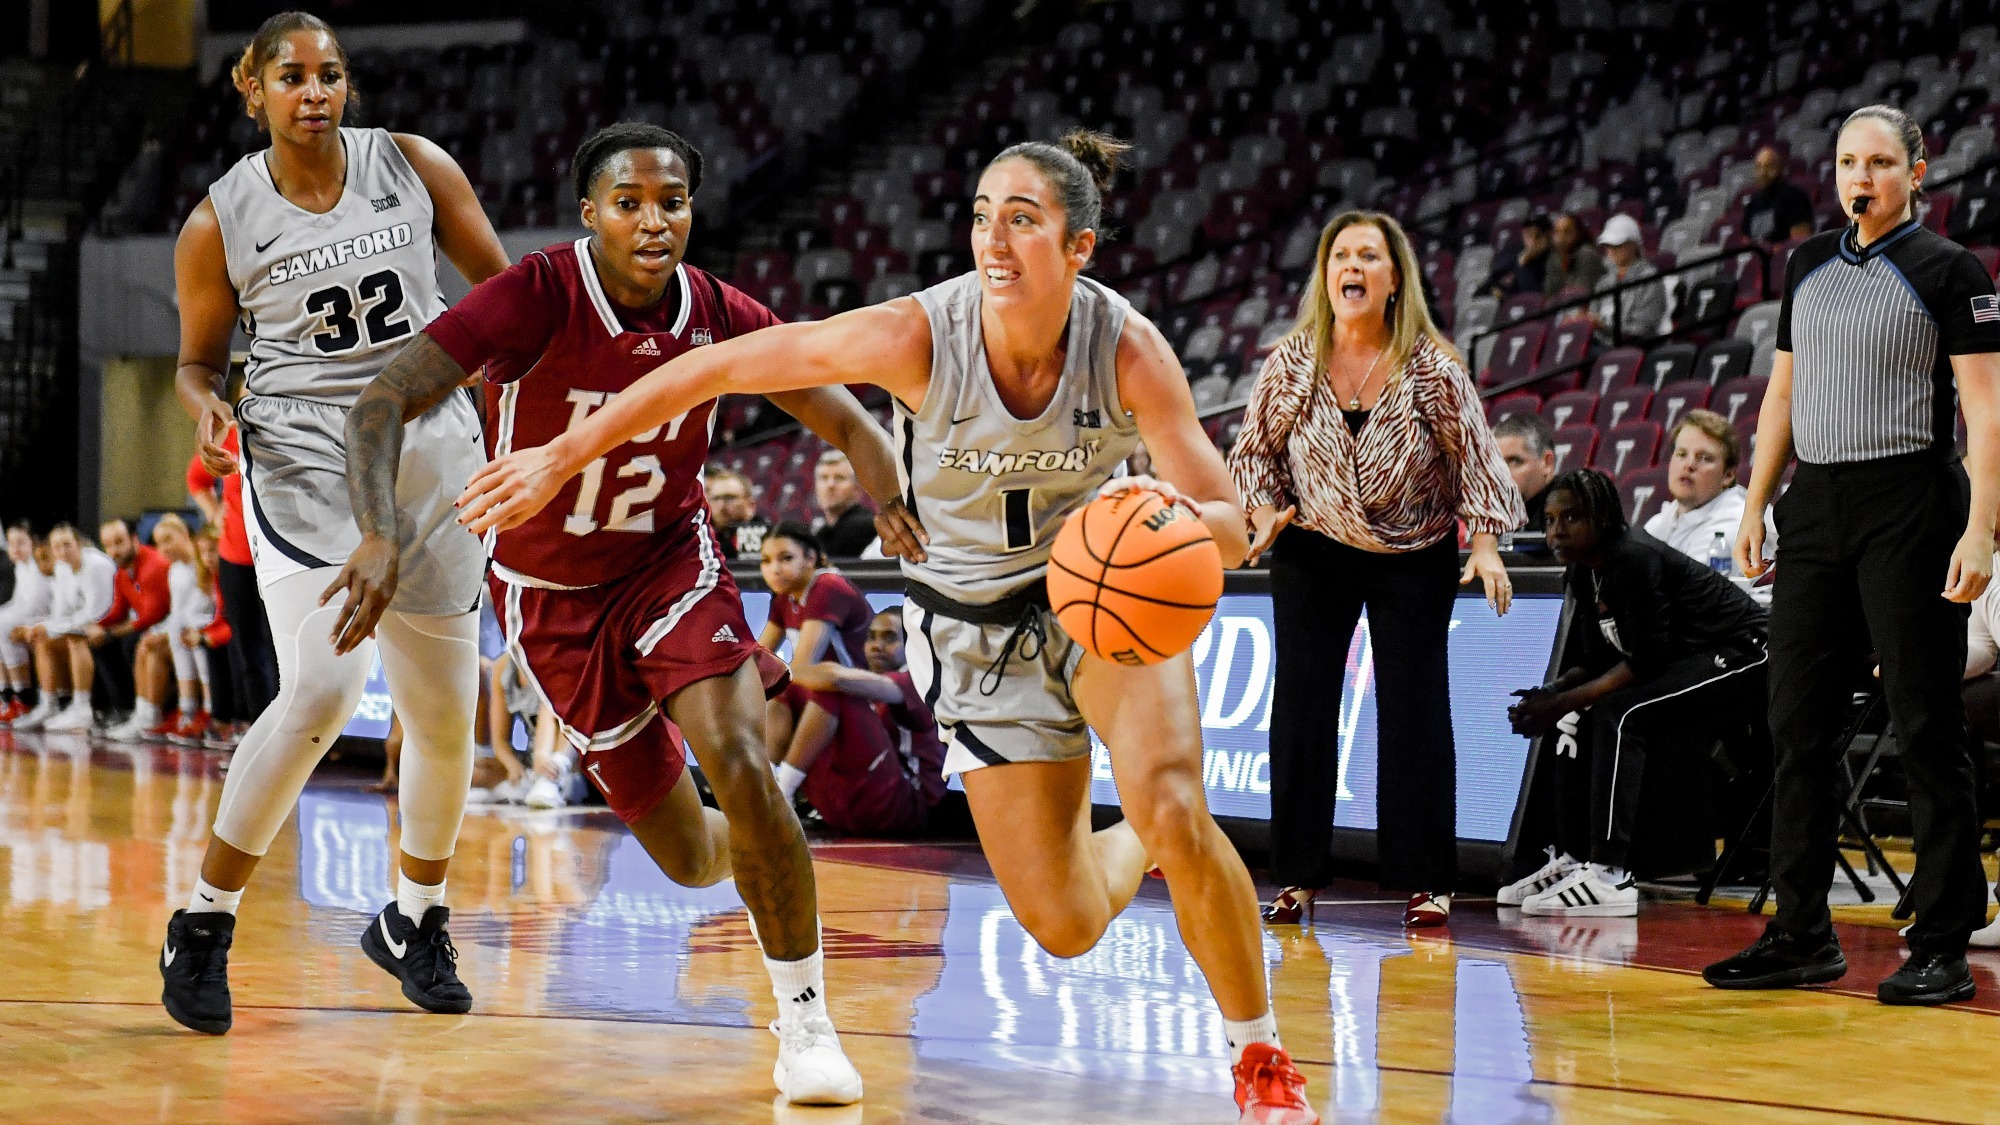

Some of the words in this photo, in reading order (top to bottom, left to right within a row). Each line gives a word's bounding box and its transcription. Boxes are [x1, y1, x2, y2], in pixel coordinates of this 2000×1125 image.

[269, 222, 412, 286] SAMFORD
[303, 265, 414, 356] 32
[631, 348, 661, 356] adidas
[563, 455, 667, 537] 12
[998, 487, 1036, 552] 1
